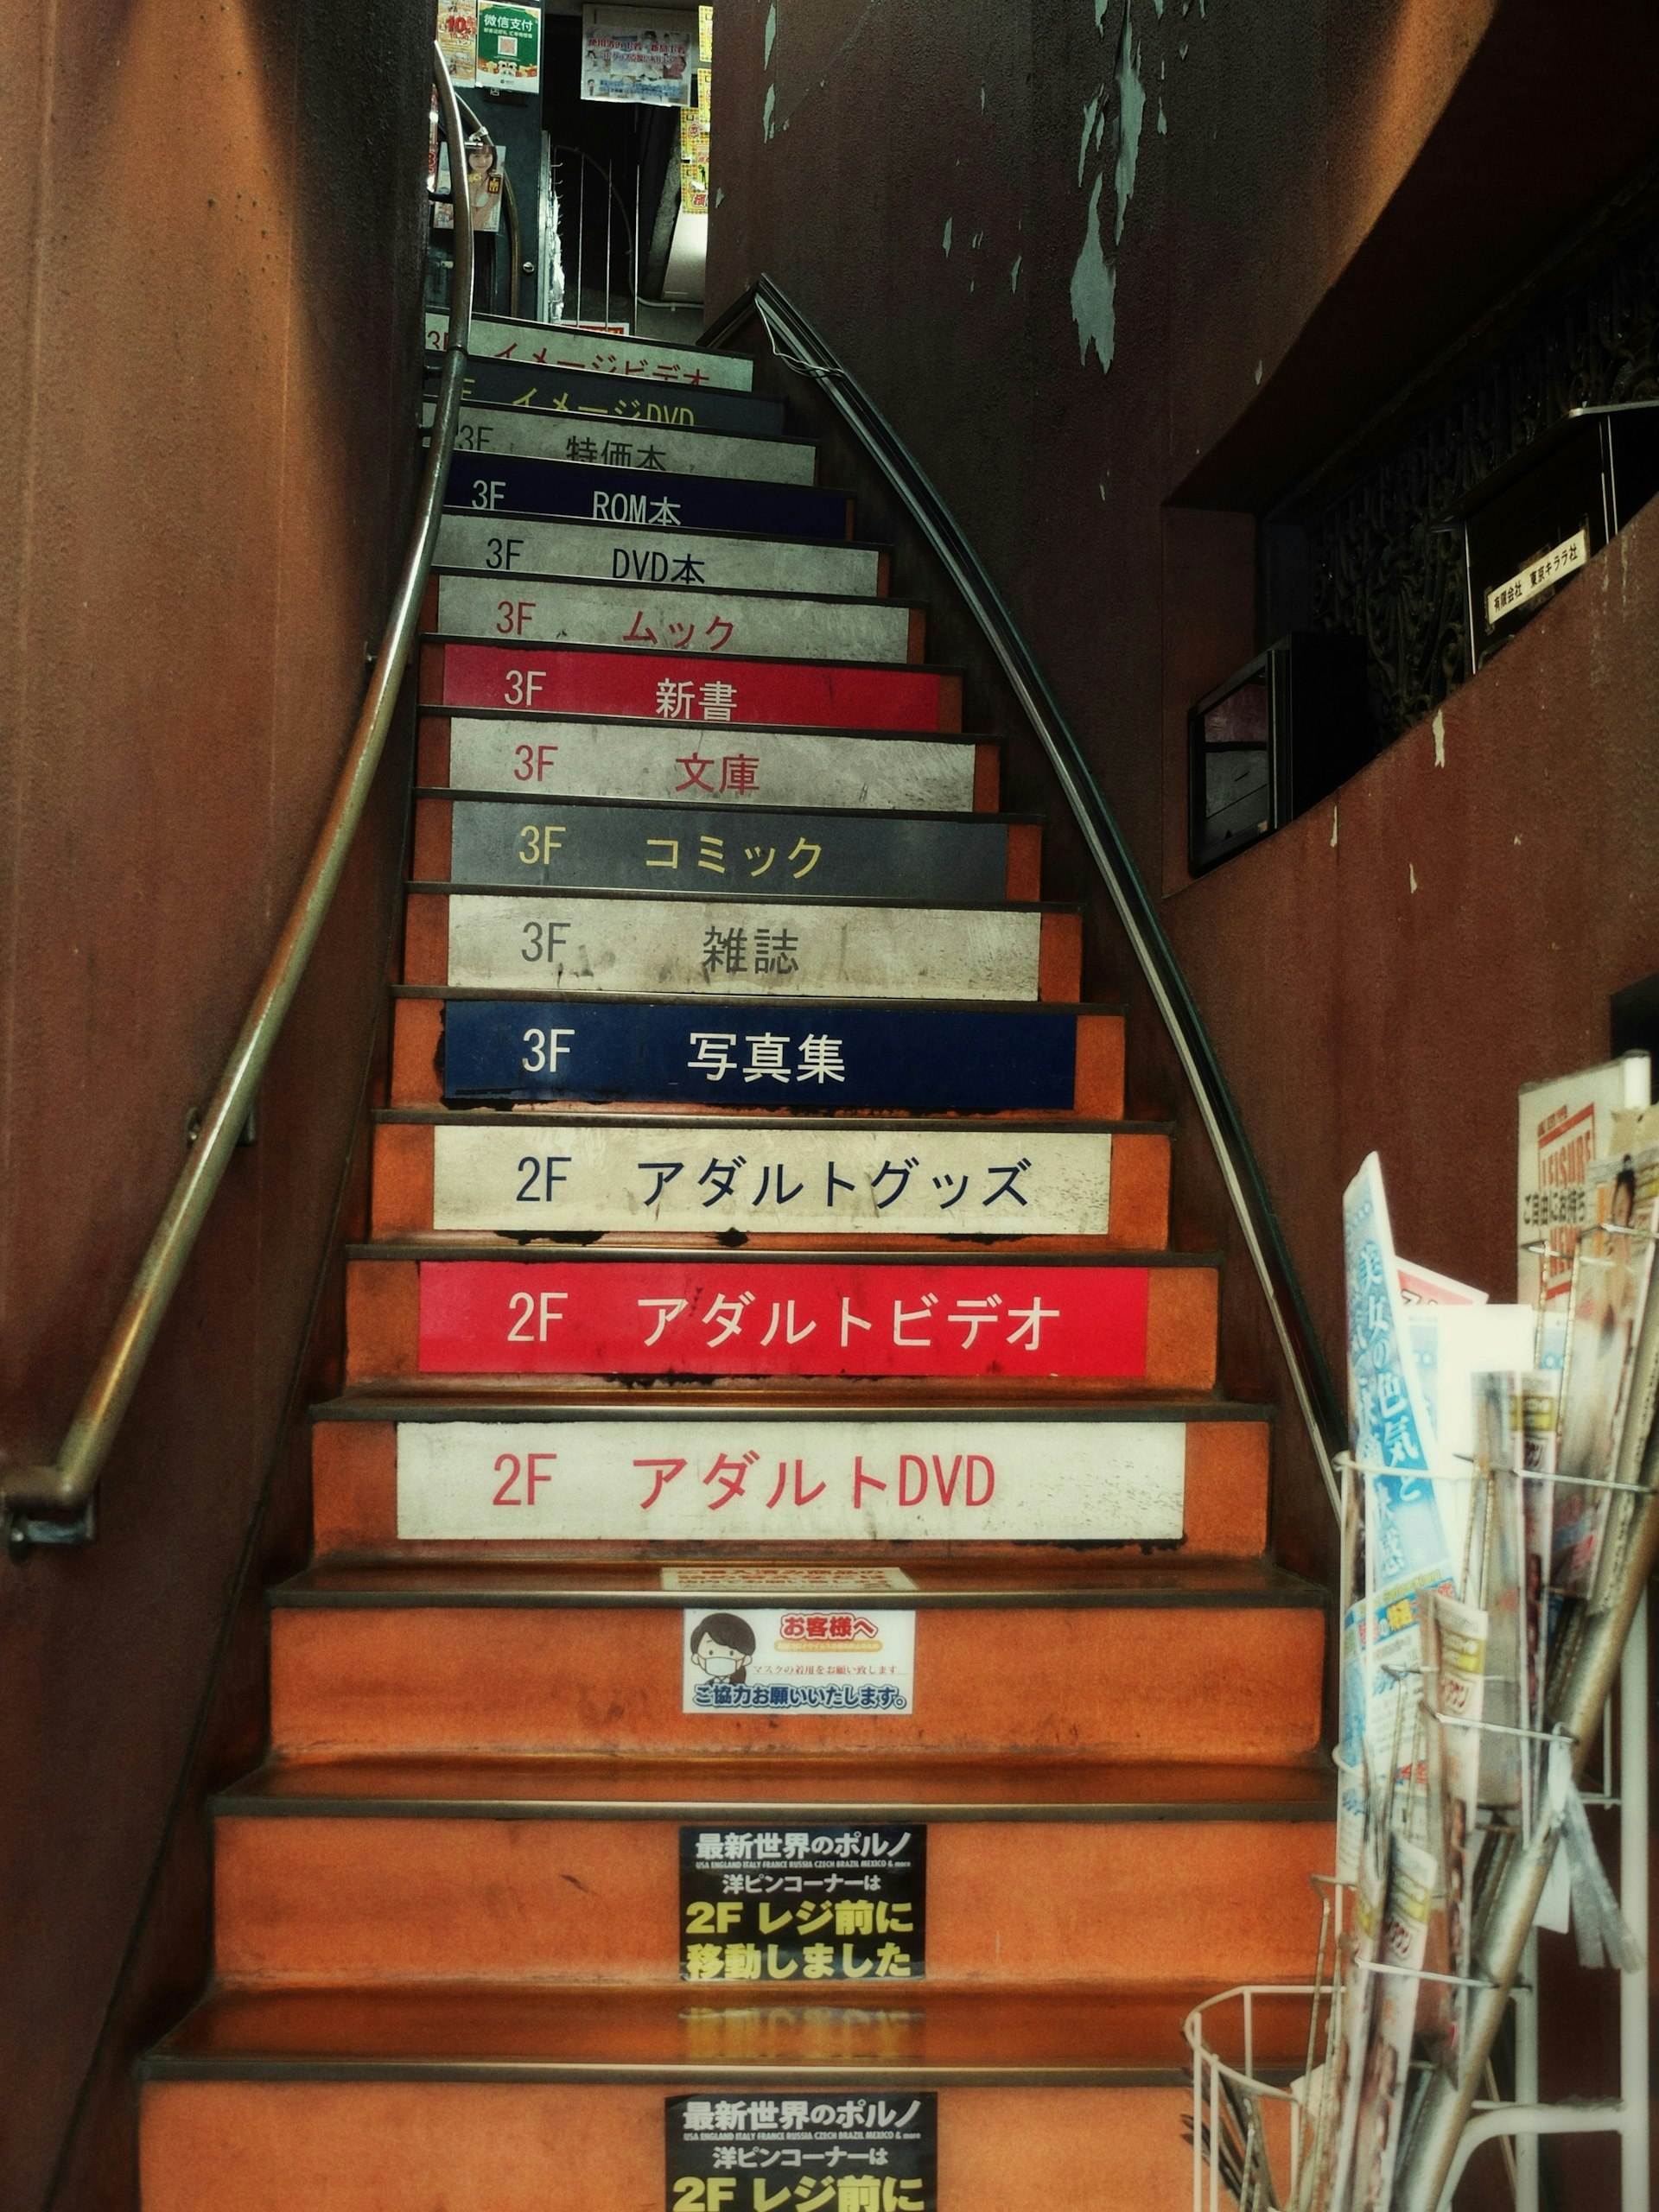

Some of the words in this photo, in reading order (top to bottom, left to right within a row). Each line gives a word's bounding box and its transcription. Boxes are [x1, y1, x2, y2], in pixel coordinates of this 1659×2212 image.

[484, 14, 533, 32] 微信支付
[428, 330, 448, 350] 3
[512, 388, 694, 427] イメージDVD
[459, 426, 493, 449] 3F
[566, 435, 666, 471] 特価本
[472, 480, 506, 510] 3F
[593, 491, 682, 526] ROM本
[486, 538, 524, 570] 3F
[612, 549, 705, 584] DVD本
[1493, 581, 1522, 613] 有限会社
[1529, 543, 1578, 588] 東京キララ社
[497, 601, 536, 634] 3F
[623, 611, 734, 651] ムック
[505, 671, 547, 707] 3F
[656, 677, 737, 721] 新書
[514, 745, 559, 781] 3F
[675, 753, 760, 794] 文庫
[518, 826, 566, 865] 3F
[646, 836, 822, 879] コミック
[521, 922, 570, 963] 3F
[702, 926, 799, 974] 雑誌
[522, 1029, 575, 1072] 3F
[688, 1032, 846, 1084] 写真集
[517, 1156, 572, 1203] 2F
[637, 1156, 1033, 1209] アダルトグッズ
[507, 1293, 569, 1343] 2F
[637, 1292, 1060, 1351] アダルトビデオ
[493, 1453, 557, 1506] 2F
[632, 1450, 996, 1511] アダルトDVD
[781, 1613, 877, 1640] お客様へ
[753, 1664, 897, 1675] マスクの着用をお願い致します
[694, 1684, 906, 1708] ご協力お願いいたします。
[696, 1831, 912, 1859] 最新世界のポルノ
[696, 1859, 709, 1868] USA
[711, 1859, 741, 1868] ENGLAND
[743, 1859, 760, 1868] ITALY
[762, 1859, 787, 1868] FRANCE
[789, 1859, 813, 1868] RUSSIA
[814, 1859, 835, 1868] CZECH
[836, 1859, 859, 1868] BRAZIL
[861, 1859, 887, 1868] MEXICO
[894, 1859, 911, 1868] more
[722, 1873, 880, 1894] 洋ピンコーナーは
[685, 1901, 743, 1933] 2F
[759, 1899, 913, 1935] レジ前に
[686, 1942, 912, 1980] 移動しました
[683, 2099, 921, 2130] 最新世界のポルノ
[683, 2132, 699, 2140] USA
[700, 2132, 734, 2140] ENGLAND
[735, 2132, 755, 2140] ITALY
[757, 2132, 785, 2140] FRANCE
[786, 2132, 812, 2140] RUSSIA
[814, 2132, 836, 2140] CZECH
[838, 2132, 864, 2140] BRAZIL
[866, 2132, 893, 2140] MEXICO
[903, 2132, 921, 2140] more
[713, 2146, 888, 2169] 洋ピンコーナーは
[673, 2176, 736, 2212] 2F
[753, 2175, 925, 2212] レジ前に
